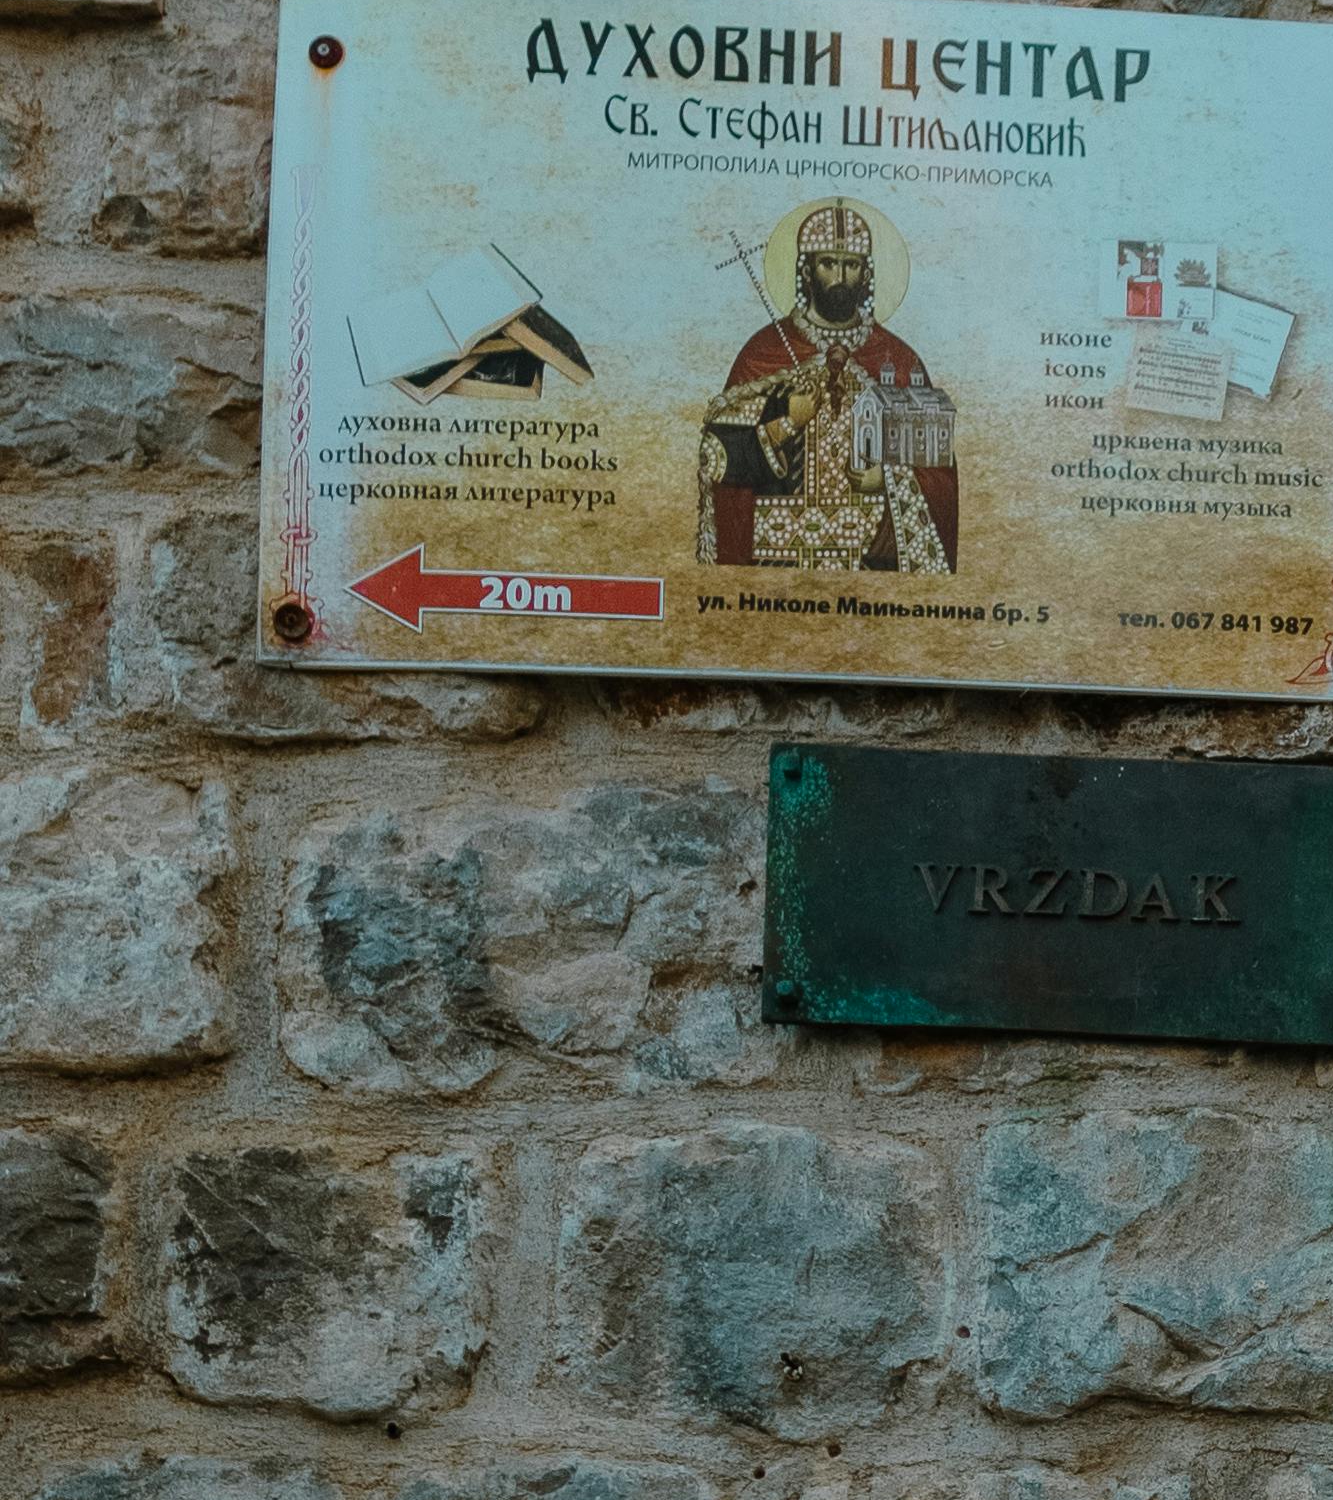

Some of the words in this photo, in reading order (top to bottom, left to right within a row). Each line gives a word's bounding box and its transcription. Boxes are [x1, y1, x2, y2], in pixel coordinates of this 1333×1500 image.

[526, 18, 842, 87] ДУХОВНИ
[881, 37, 1150, 103] ЦЕНТАР
[627, 152, 780, 175] МИТРОПОЛИЈА
[785, 158, 1054, 188] ЦРНОГОРСКО-ПРИМОРСКА
[1040, 331, 1113, 349] иконе
[1044, 358, 1106, 379] icons
[1045, 394, 1104, 410] икон
[337, 414, 442, 434] духовна
[449, 416, 600, 443] литература
[319, 443, 437, 468] orthodox
[444, 445, 532, 470] church
[540, 450, 618, 472] books
[1092, 434, 1192, 451] црквена
[1200, 440, 1283, 460] музика
[1050, 458, 1160, 481] orthodox
[1167, 462, 1248, 485] church
[1254, 468, 1324, 488] music
[319, 481, 458, 506] церковная
[464, 486, 617, 513] литература
[1203, 501, 1292, 521] музыка
[479, 576, 572, 612] 20m
[697, 595, 732, 614] ул.
[738, 592, 830, 615] Николе
[992, 603, 1030, 626] бр.
[1036, 606, 1051, 624] 5
[1119, 612, 1165, 629] тел.
[1171, 611, 1214, 630] 067
[1221, 614, 1262, 633] 841
[1269, 616, 1314, 636] 987
[913, 863, 1242, 924] VRZDAK
